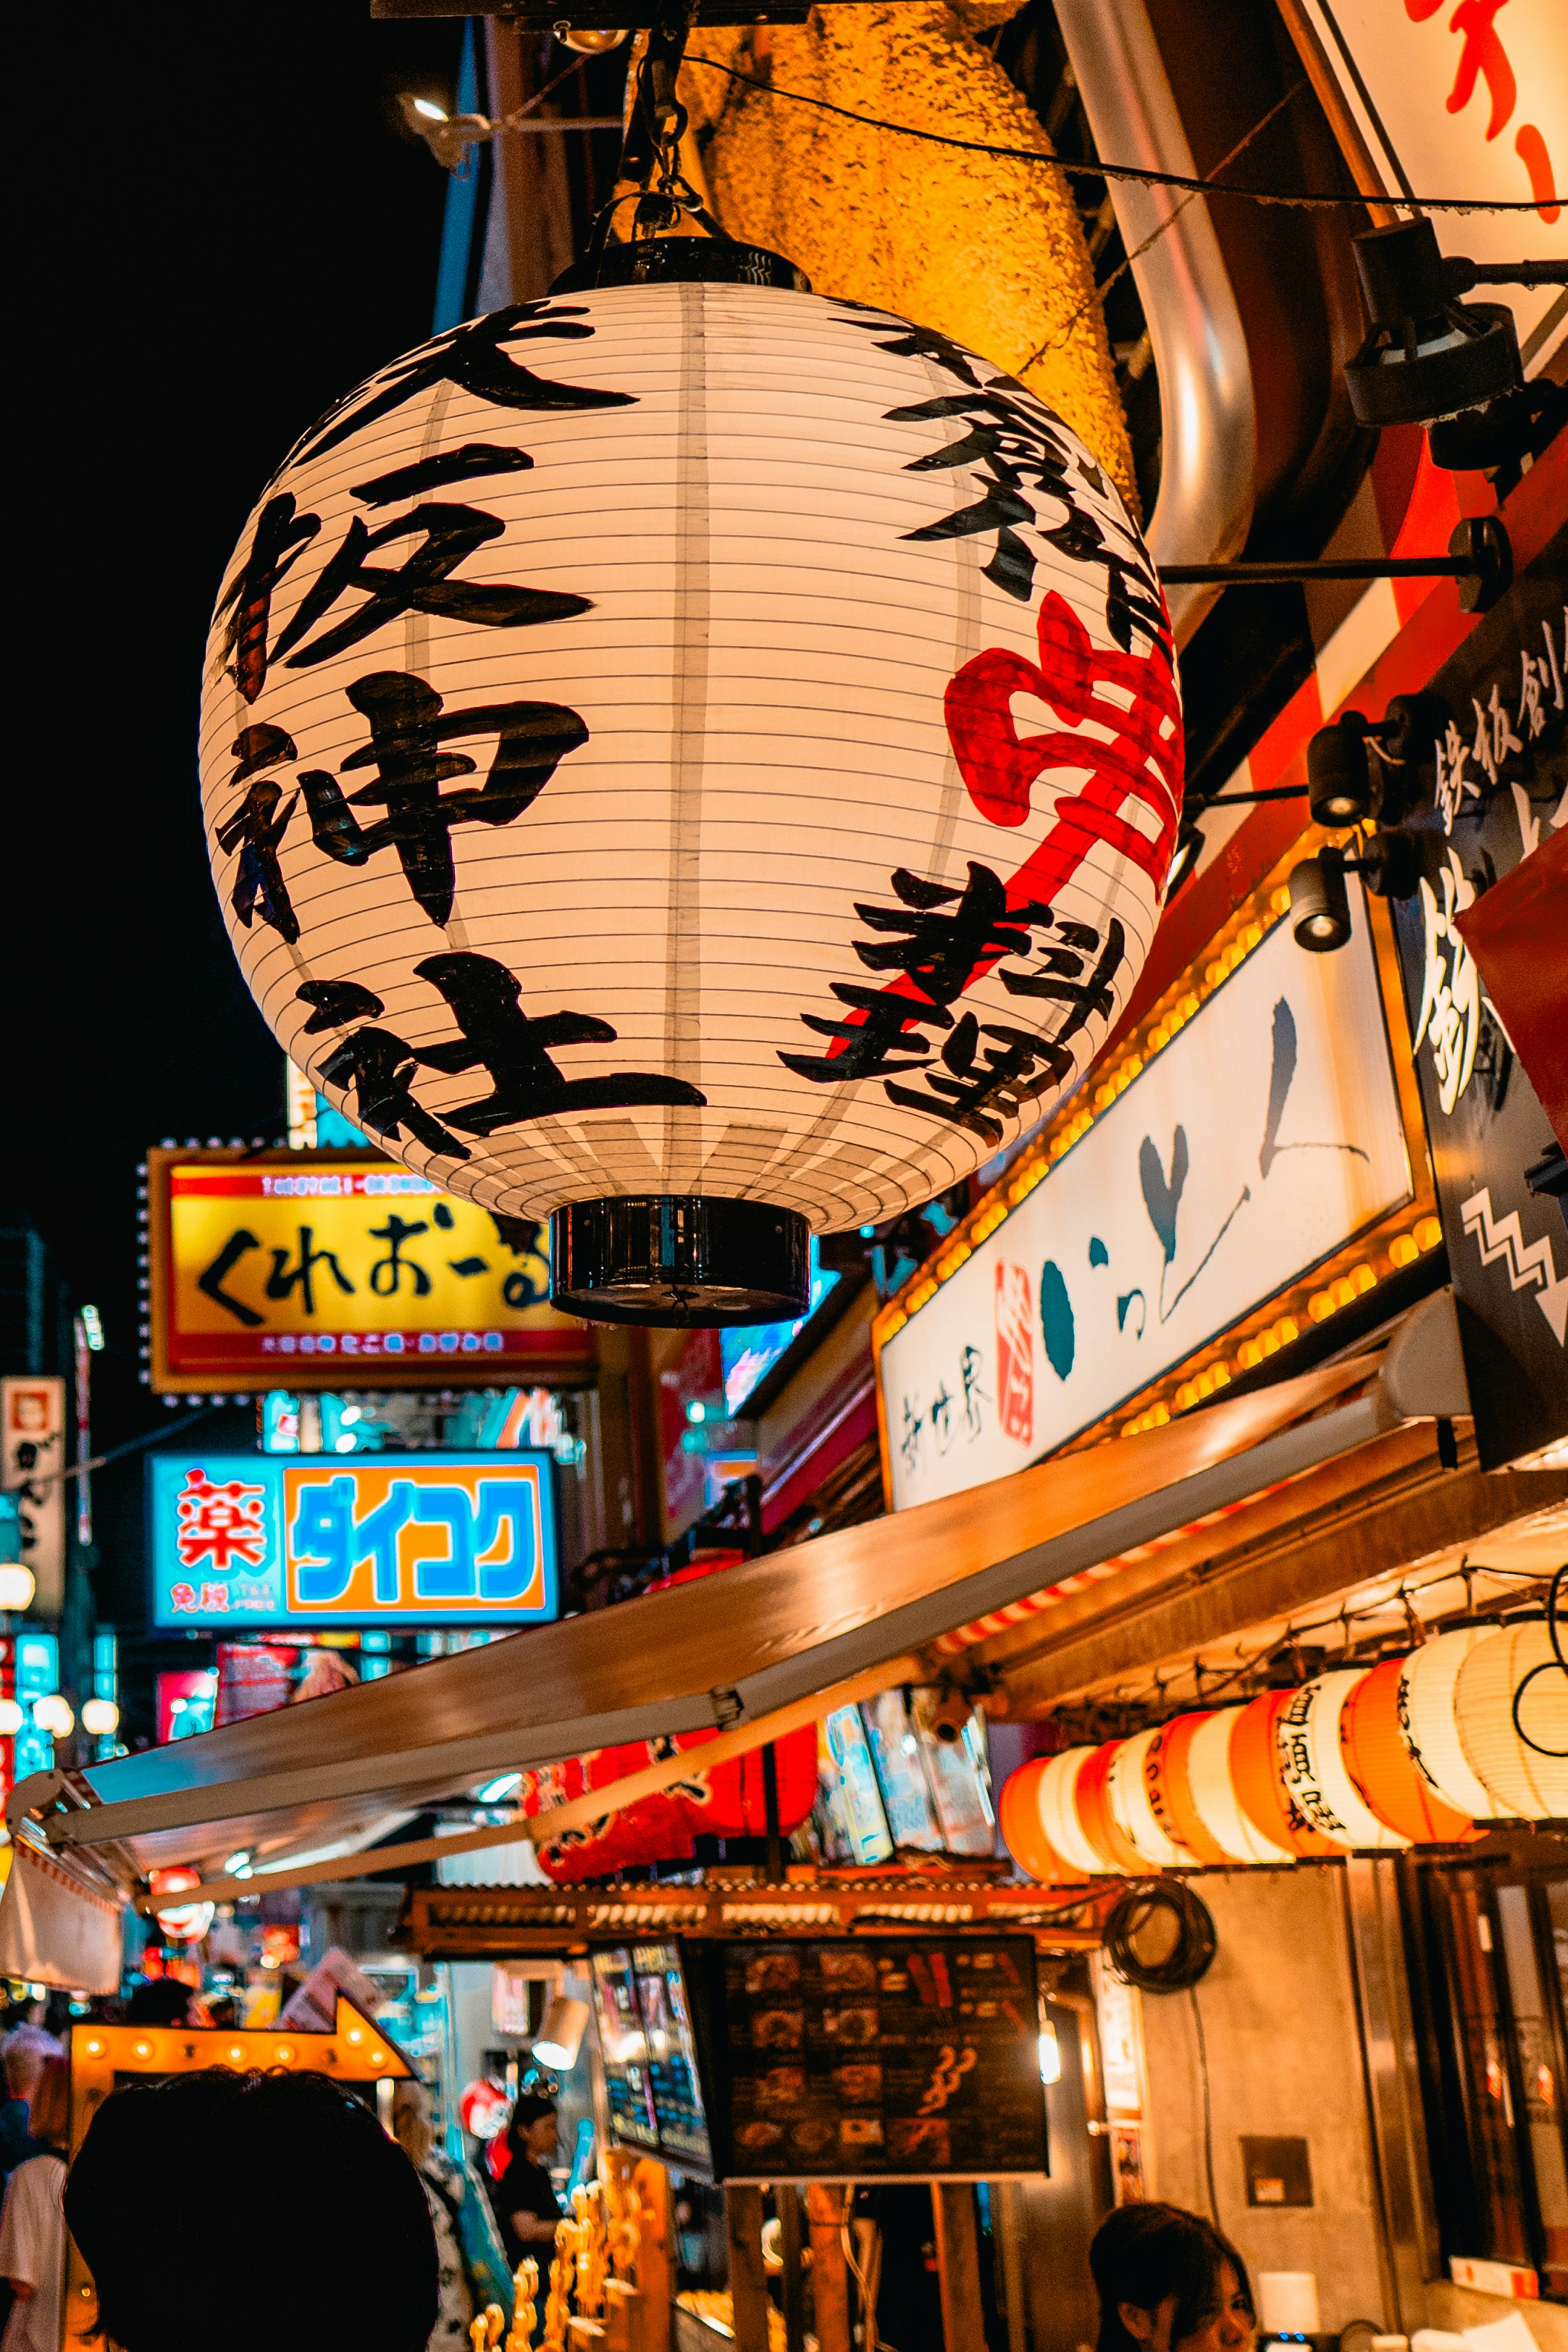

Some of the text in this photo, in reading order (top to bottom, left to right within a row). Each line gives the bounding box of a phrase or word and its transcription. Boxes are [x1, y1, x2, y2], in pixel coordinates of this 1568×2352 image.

[1434, 606, 1568, 837] 鉄板創
[176, 1467, 269, 1572] 薬
[293, 1474, 540, 1604] ダイコク
